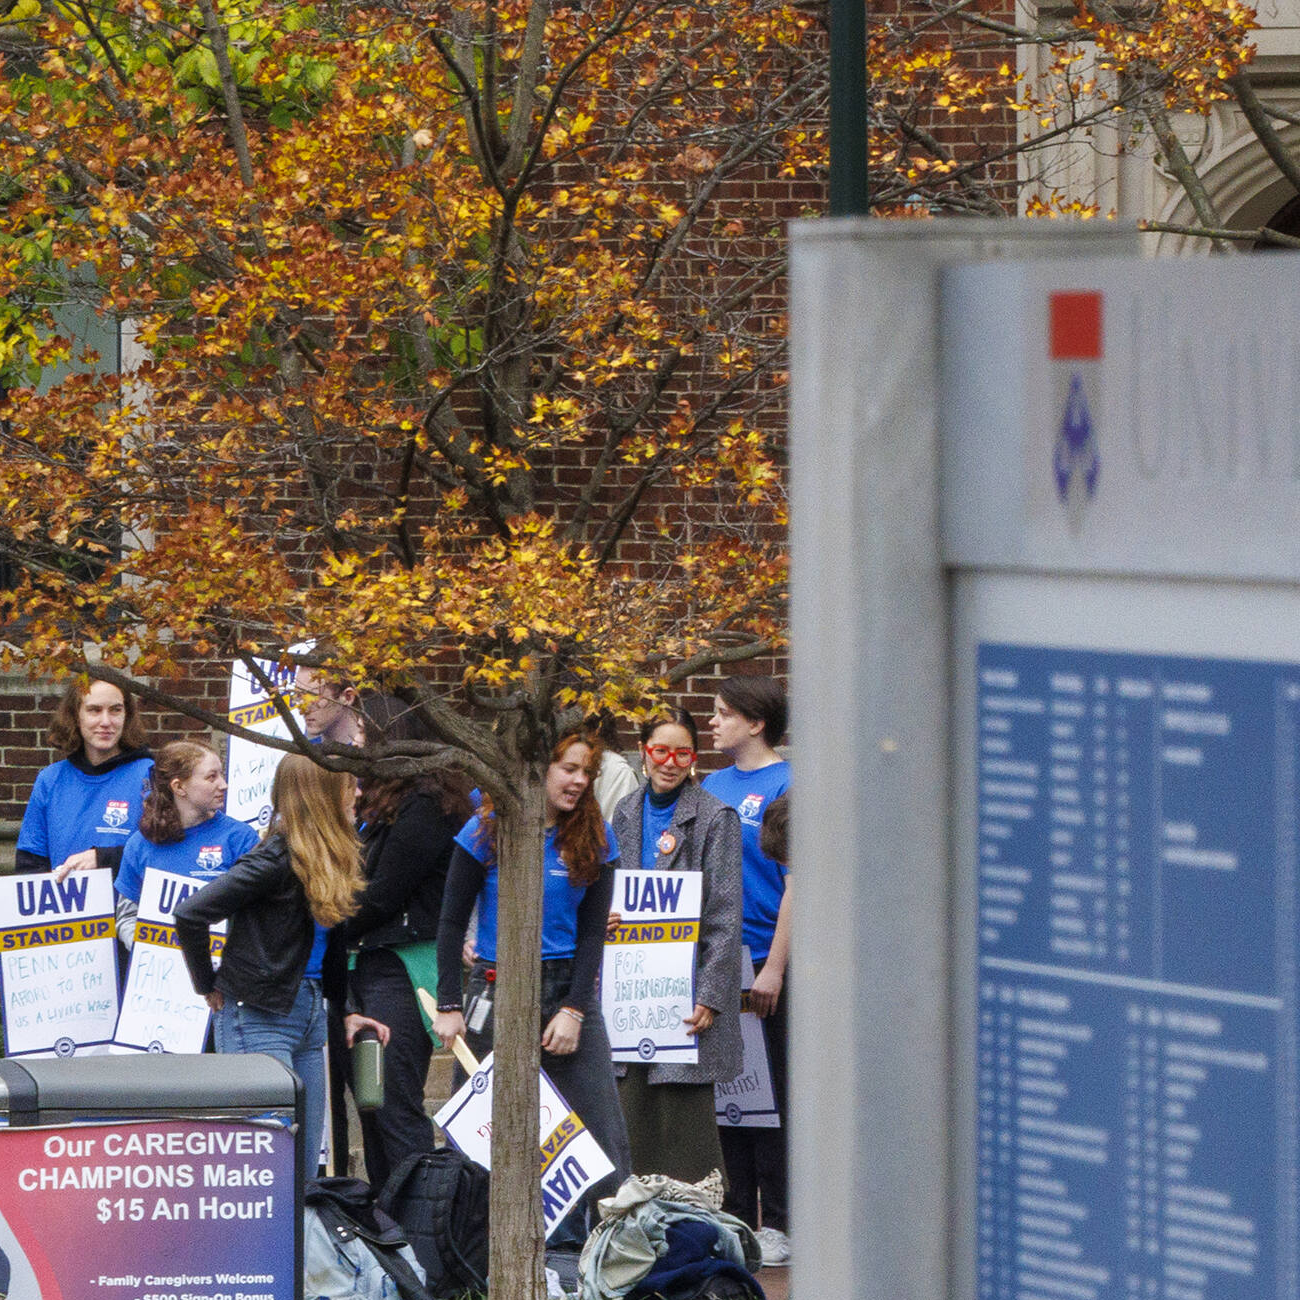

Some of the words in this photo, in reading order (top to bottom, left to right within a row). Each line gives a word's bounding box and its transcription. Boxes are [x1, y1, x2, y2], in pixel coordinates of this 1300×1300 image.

[234, 704, 277, 726] STAN
[16, 876, 89, 916] UAW
[158, 878, 199, 914] UA
[624, 876, 683, 913] UAW
[3, 926, 74, 948] STAND
[81, 922, 109, 938] UP
[138, 926, 180, 946] STAN
[606, 926, 664, 942] STAND
[670, 925, 693, 940] UP
[7, 955, 59, 980] PENN
[66, 950, 95, 969] CAN
[614, 950, 645, 979] FOR
[57, 979, 73, 994] TO
[83, 972, 102, 990] PAY
[612, 1005, 681, 1032] GRADS
[44, 1136, 95, 1158] Our
[103, 1132, 274, 1156] CAREGIVER
[18, 1164, 194, 1191] CHAMPIONS
[203, 1164, 274, 1187] Make
[97, 1198, 144, 1223] $15
[151, 1198, 189, 1220] An
[199, 1196, 273, 1219] Hour!
[99, 1275, 141, 1287] Family
[144, 1274, 212, 1287] Caregivers
[215, 1273, 274, 1284] Welcome
